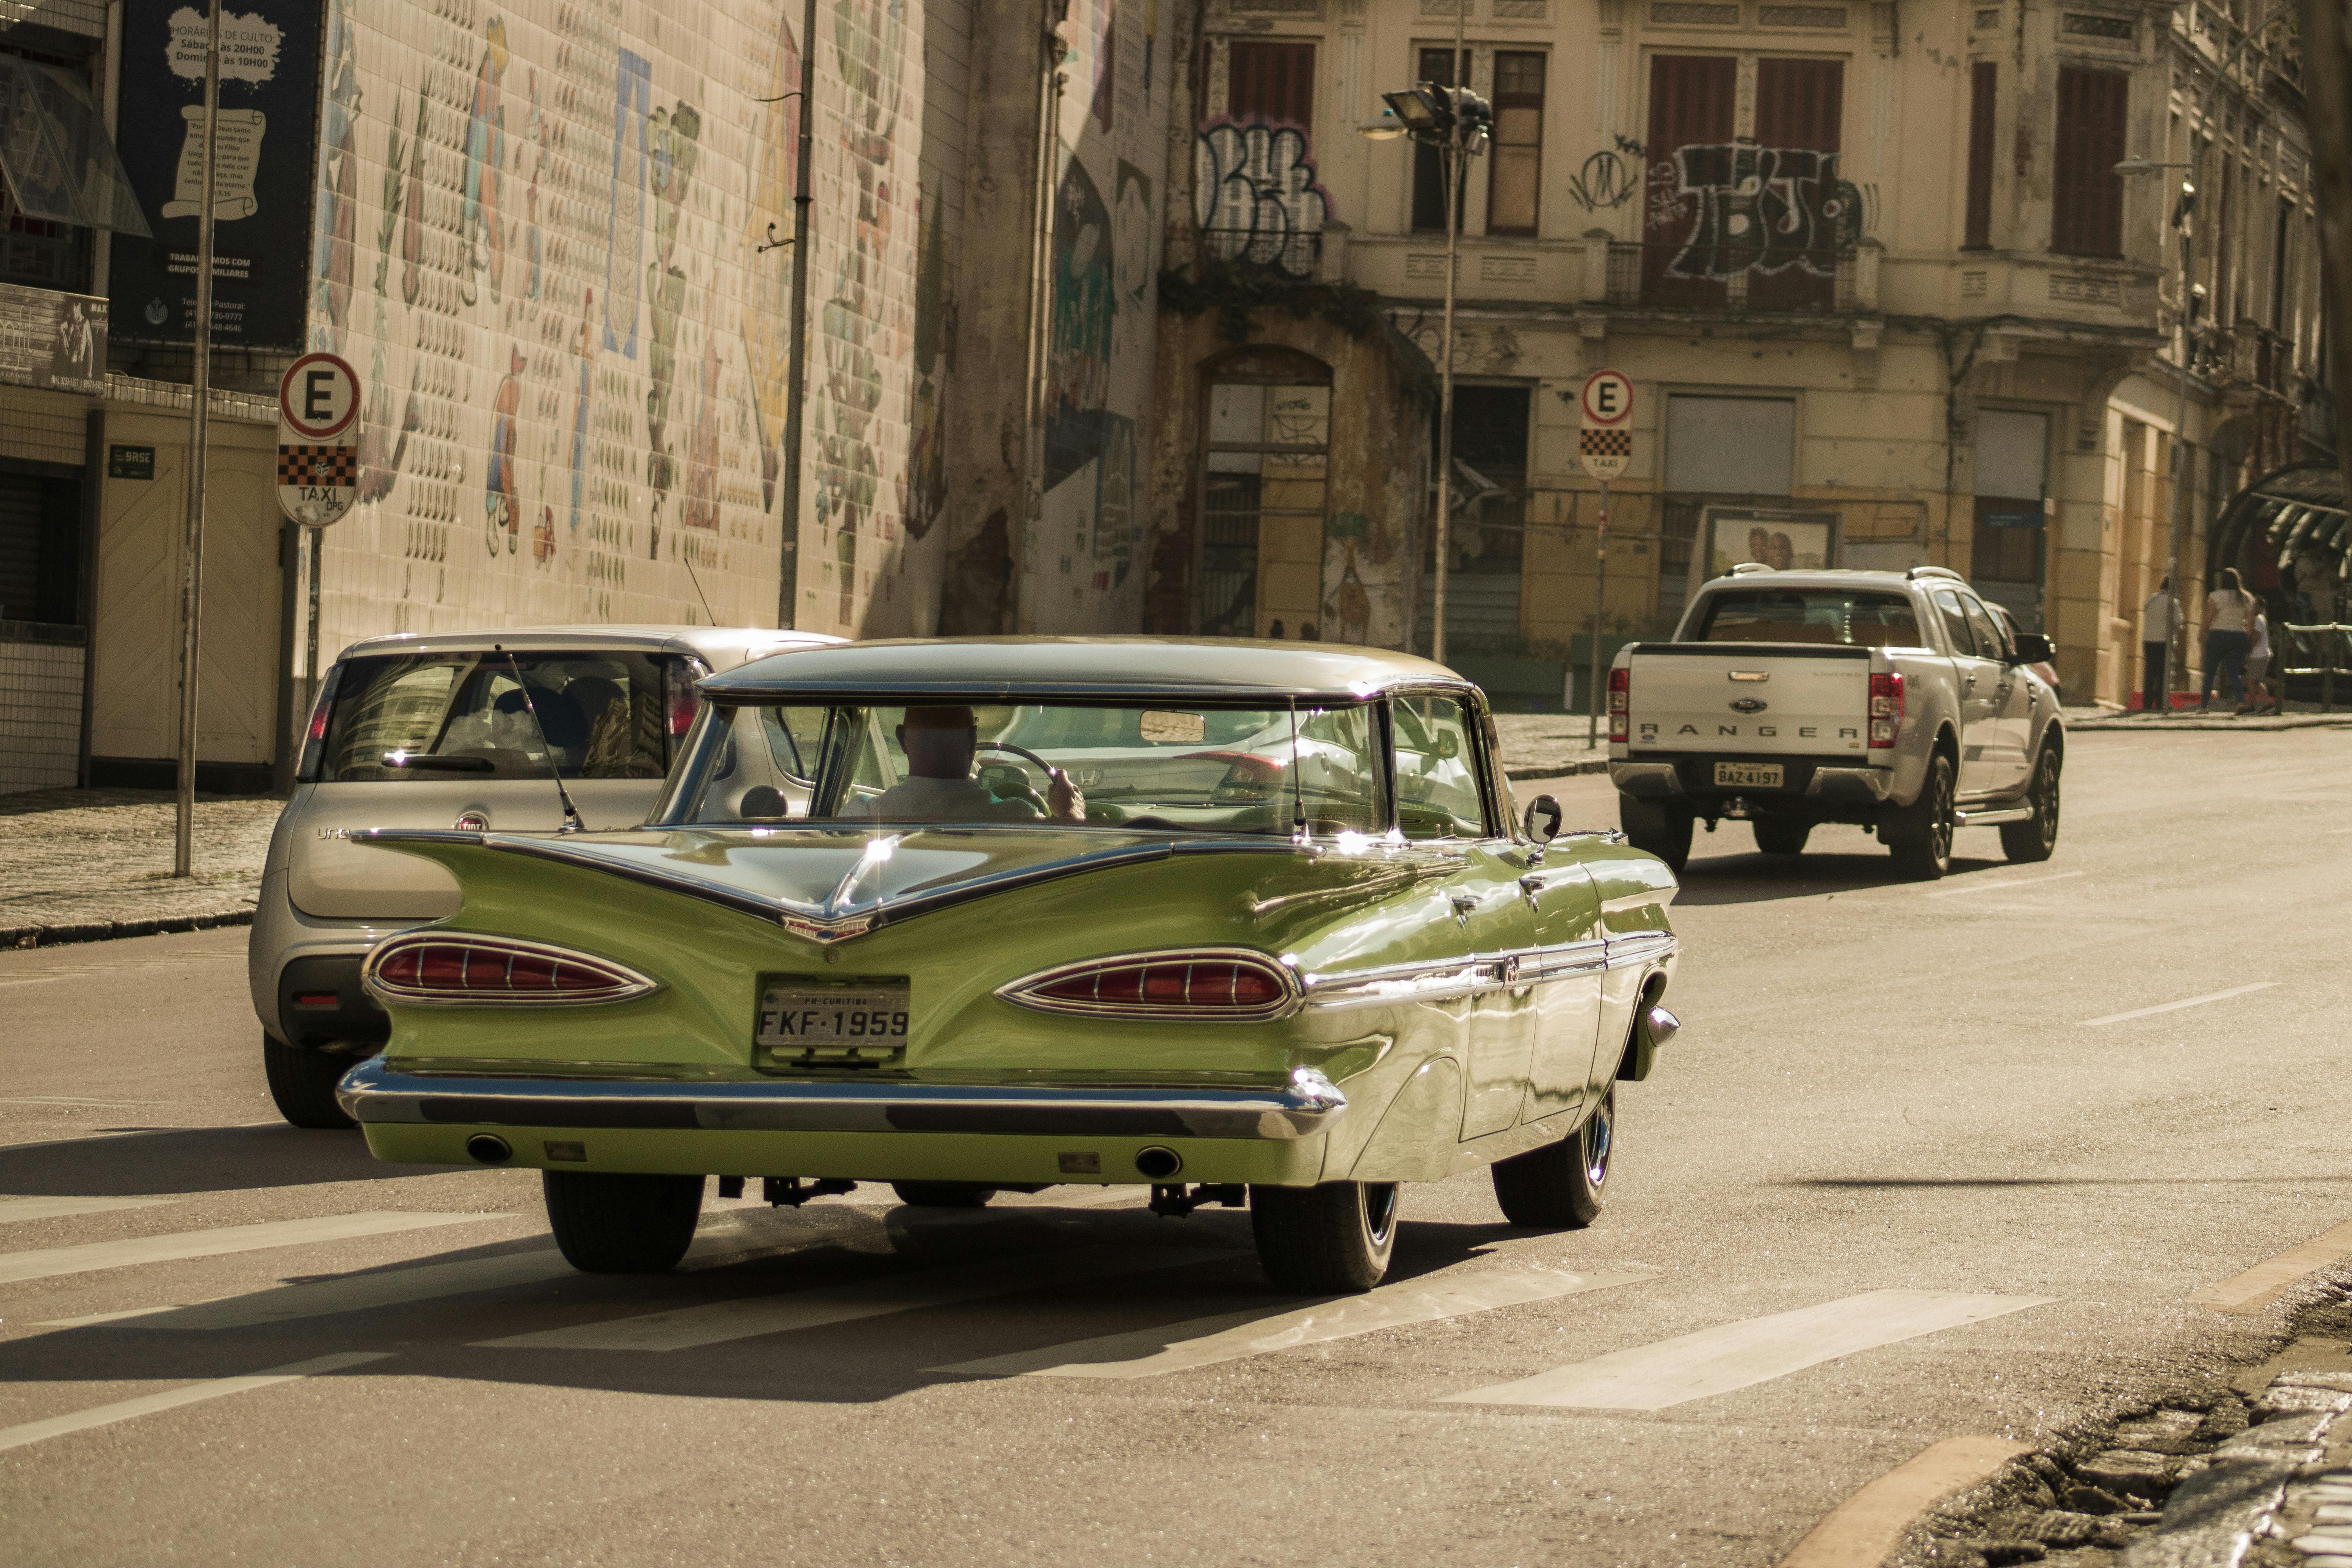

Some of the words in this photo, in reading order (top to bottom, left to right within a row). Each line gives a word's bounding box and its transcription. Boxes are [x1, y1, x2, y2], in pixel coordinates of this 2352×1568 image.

[225, 30, 238, 40] DE
[240, 32, 275, 44] CULTO:
[220, 42, 231, 51] às
[234, 44, 265, 54] 20H00
[224, 55, 235, 65] às
[238, 57, 268, 68] 10H00
[232, 258, 250, 267] COM
[91, 303, 107, 313] MAX
[215, 300, 246, 310] Pastoral:
[305, 370, 335, 420] E
[1599, 382, 1617, 412] E
[1593, 458, 1618, 467] TAXI
[298, 486, 336, 502] TAXI
[1640, 723, 1858, 739] RANGER
